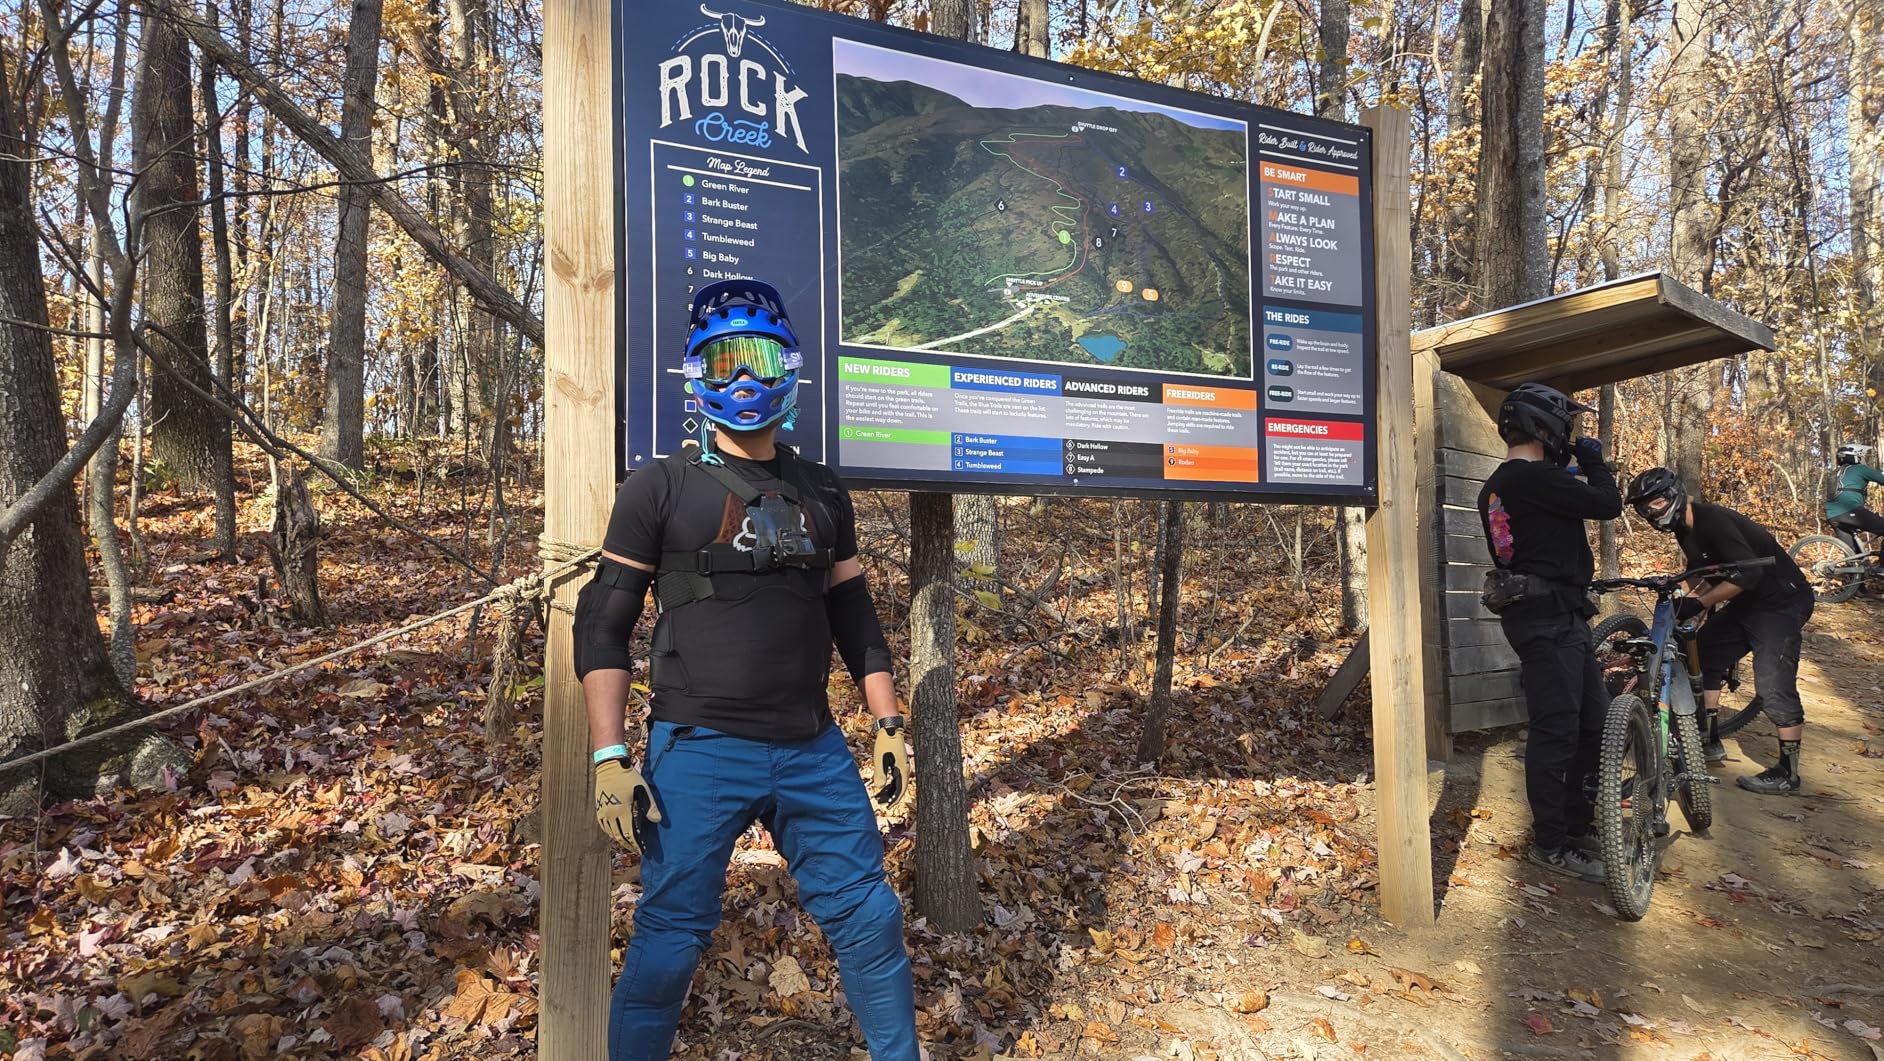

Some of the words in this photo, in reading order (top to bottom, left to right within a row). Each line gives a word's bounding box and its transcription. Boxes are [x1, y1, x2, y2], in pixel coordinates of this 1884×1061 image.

[659, 54, 809, 154] ROCK
[696, 112, 772, 148] Creek
[1259, 133, 1278, 146] Rider
[1279, 137, 1298, 148] Built
[1308, 142, 1326, 154] Rider
[1327, 146, 1358, 159] Approved
[707, 157, 732, 172] Map
[735, 160, 770, 177] Legend
[1119, 168, 1125, 177] 2
[1264, 168, 1276, 177] BE
[1277, 169, 1306, 182] SMART
[702, 180, 727, 191] Green
[729, 184, 749, 194] River
[1268, 187, 1296, 200] START
[1299, 192, 1330, 206] SMALL
[702, 197, 721, 207] Bark
[723, 200, 748, 211] Buster
[998, 201, 1004, 210] 6
[1111, 205, 1117, 214] 4
[1146, 202, 1151, 211] 3
[702, 215, 734, 227] Strange
[736, 220, 757, 230] Beast
[1268, 210, 1297, 224] MAKE
[1300, 216, 1307, 225] A
[1309, 217, 1335, 229] PLAN
[702, 232, 754, 247] Tumbleweed
[1112, 228, 1117, 238] 7
[1096, 238, 1102, 247] 8
[1269, 233, 1307, 246] ALWAYS
[1310, 238, 1338, 250] LOOK
[703, 252, 716, 262] Big
[719, 254, 739, 264] Baby
[1269, 252, 1311, 267] RESPECT
[703, 269, 723, 279] Dark
[1269, 274, 1294, 287] TAKE
[1297, 278, 1305, 288] IT
[1308, 280, 1332, 291] EASY
[1266, 311, 1283, 322] THE
[1285, 313, 1309, 324] RIDES
[845, 363, 871, 374] NEW
[873, 365, 910, 378] RIDERS
[954, 373, 1021, 386] EXPERIENCED
[1024, 378, 1057, 389] RIDERS
[1065, 381, 1116, 395] ADVANCED
[1118, 384, 1149, 396] RIDERS
[1167, 389, 1216, 401] FREERIDERS
[1268, 422, 1328, 435] EMERGENCIES
